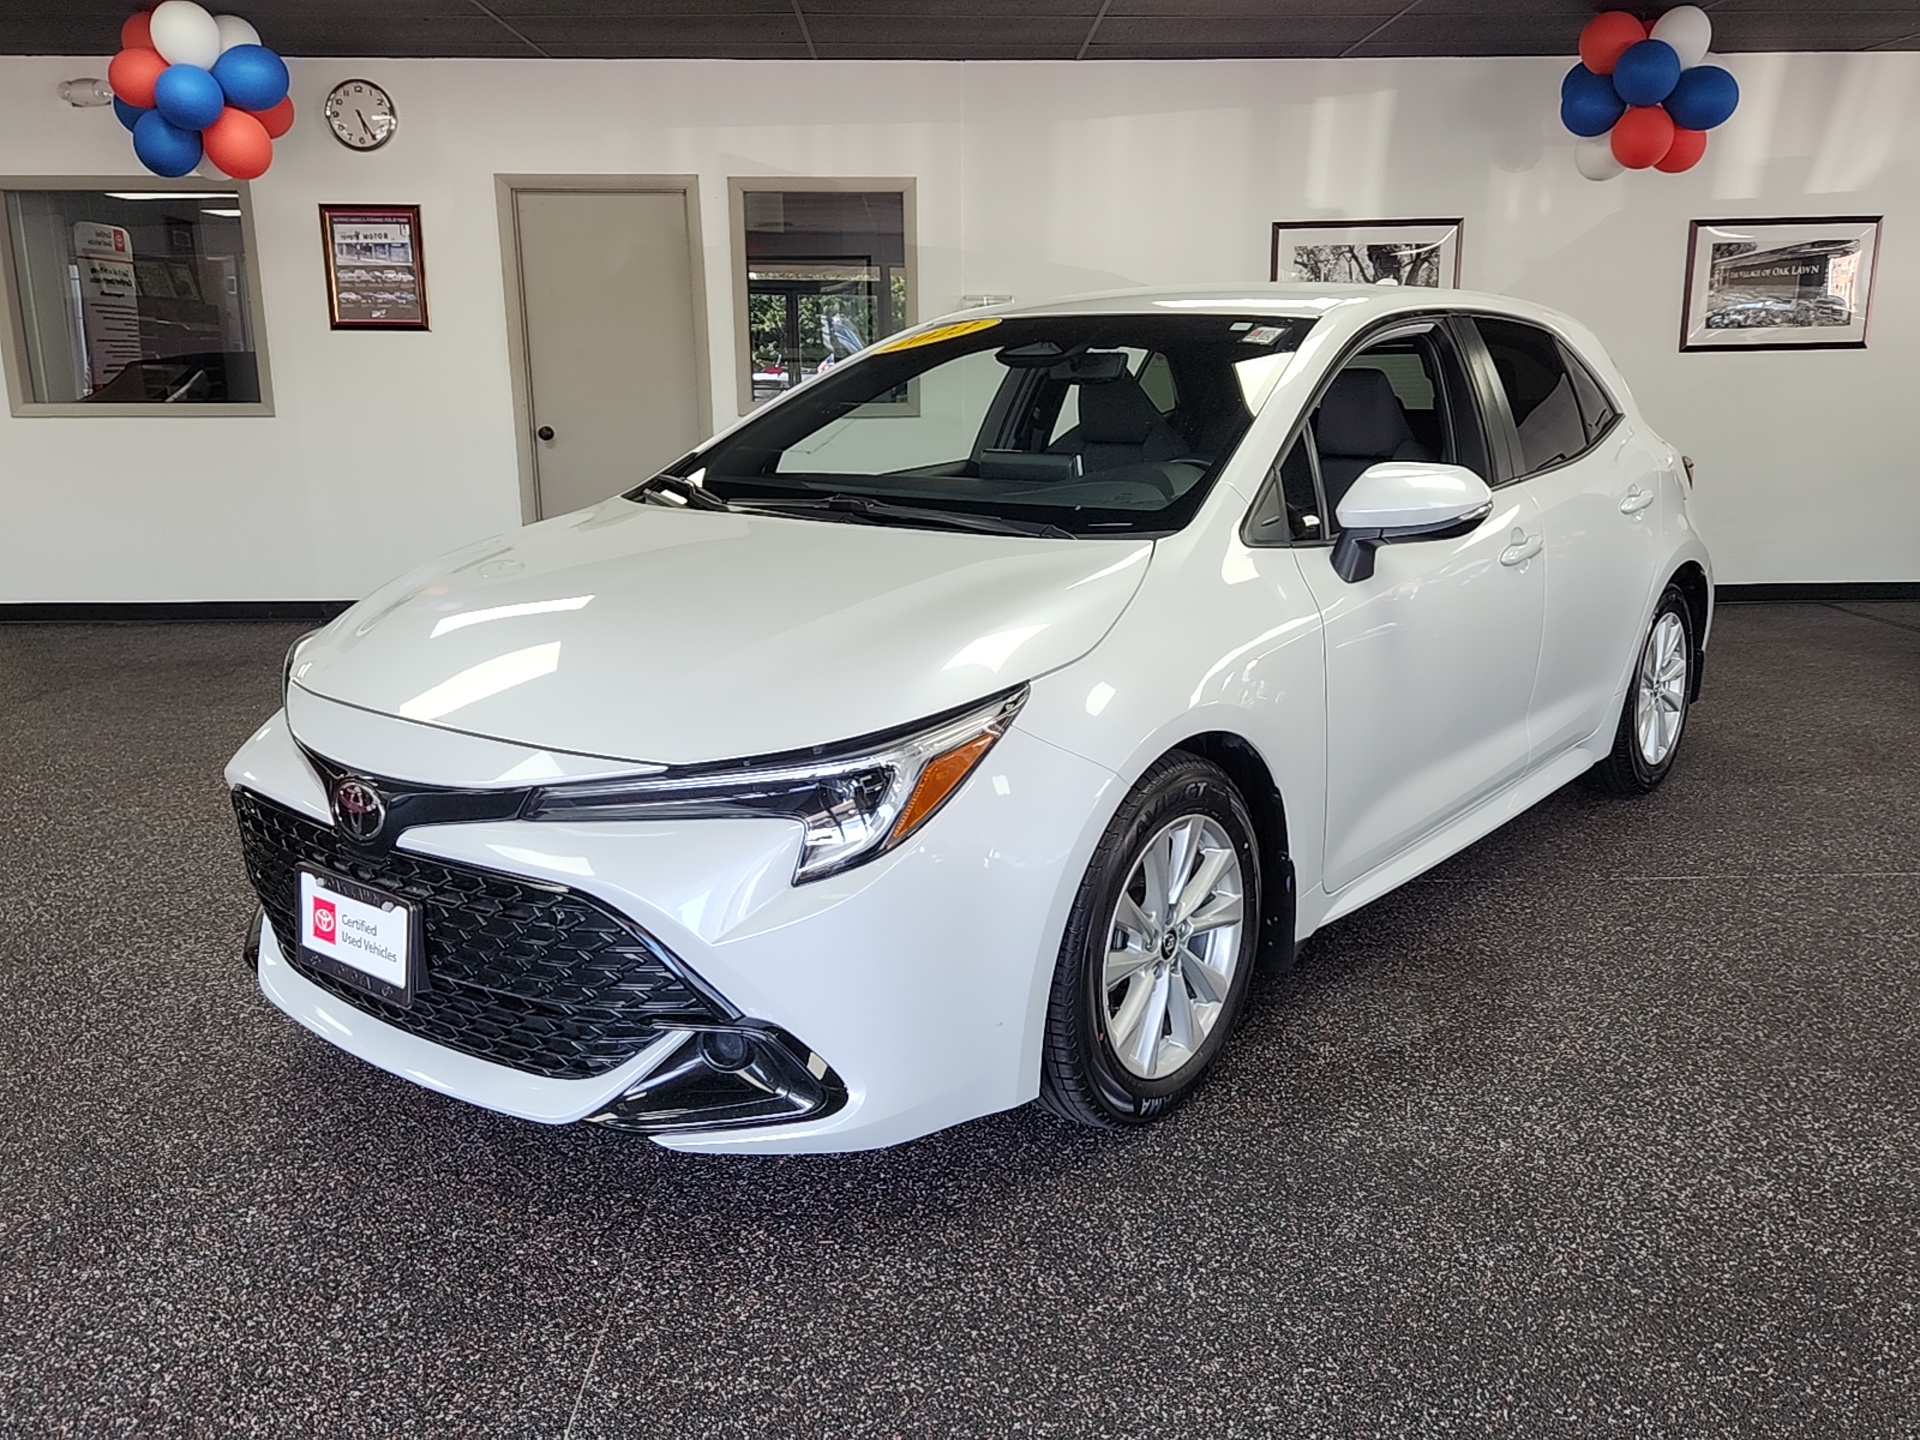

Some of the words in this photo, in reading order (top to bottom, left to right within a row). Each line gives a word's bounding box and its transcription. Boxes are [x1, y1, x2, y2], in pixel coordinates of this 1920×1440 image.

[354, 85, 363, 93] 12
[377, 98, 384, 106] 2
[347, 132, 354, 141] 7
[359, 136, 366, 145] 6
[362, 232, 389, 240] MOTOR
[1761, 268, 1771, 277] OF
[1772, 266, 1790, 276] OAK
[1791, 264, 1820, 276] LAWN
[341, 913, 378, 937] Certified
[341, 931, 363, 949] Used
[363, 938, 398, 963] Vehicles
